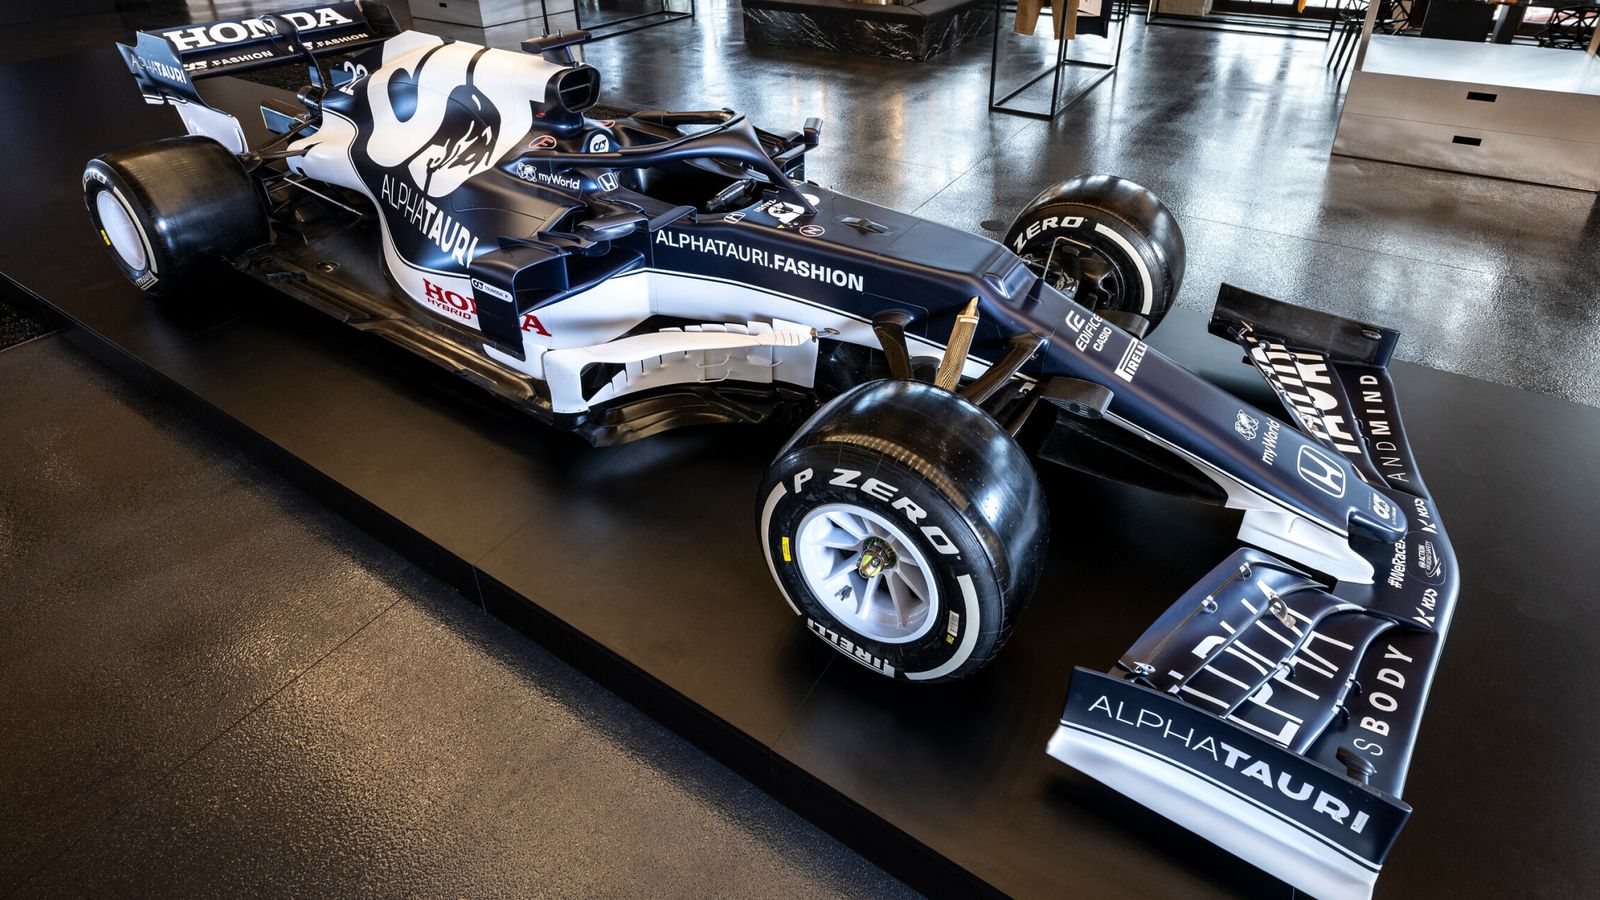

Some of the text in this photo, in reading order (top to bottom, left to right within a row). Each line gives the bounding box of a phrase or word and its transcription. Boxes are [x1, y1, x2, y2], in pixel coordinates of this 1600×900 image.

[163, 7, 353, 51] HONDA
[339, 61, 368, 96] 22
[538, 172, 580, 190] myWorld
[381, 173, 479, 269] ALPHATAURI
[1013, 216, 1085, 254] ZERO
[655, 229, 864, 292] ALPHATAURI.FASHION
[427, 298, 472, 320] HYBRID
[1075, 312, 1103, 352] EDIFICE
[1093, 326, 1112, 352] CASIO
[1262, 417, 1281, 465] myWorld
[1360, 374, 1410, 483] AND MIND
[793, 467, 814, 494] P
[828, 467, 961, 556] ZERO
[807, 617, 896, 679] PIRELLI
[1358, 643, 1413, 737] BODY
[1088, 694, 1370, 834] ALPHATAURI
